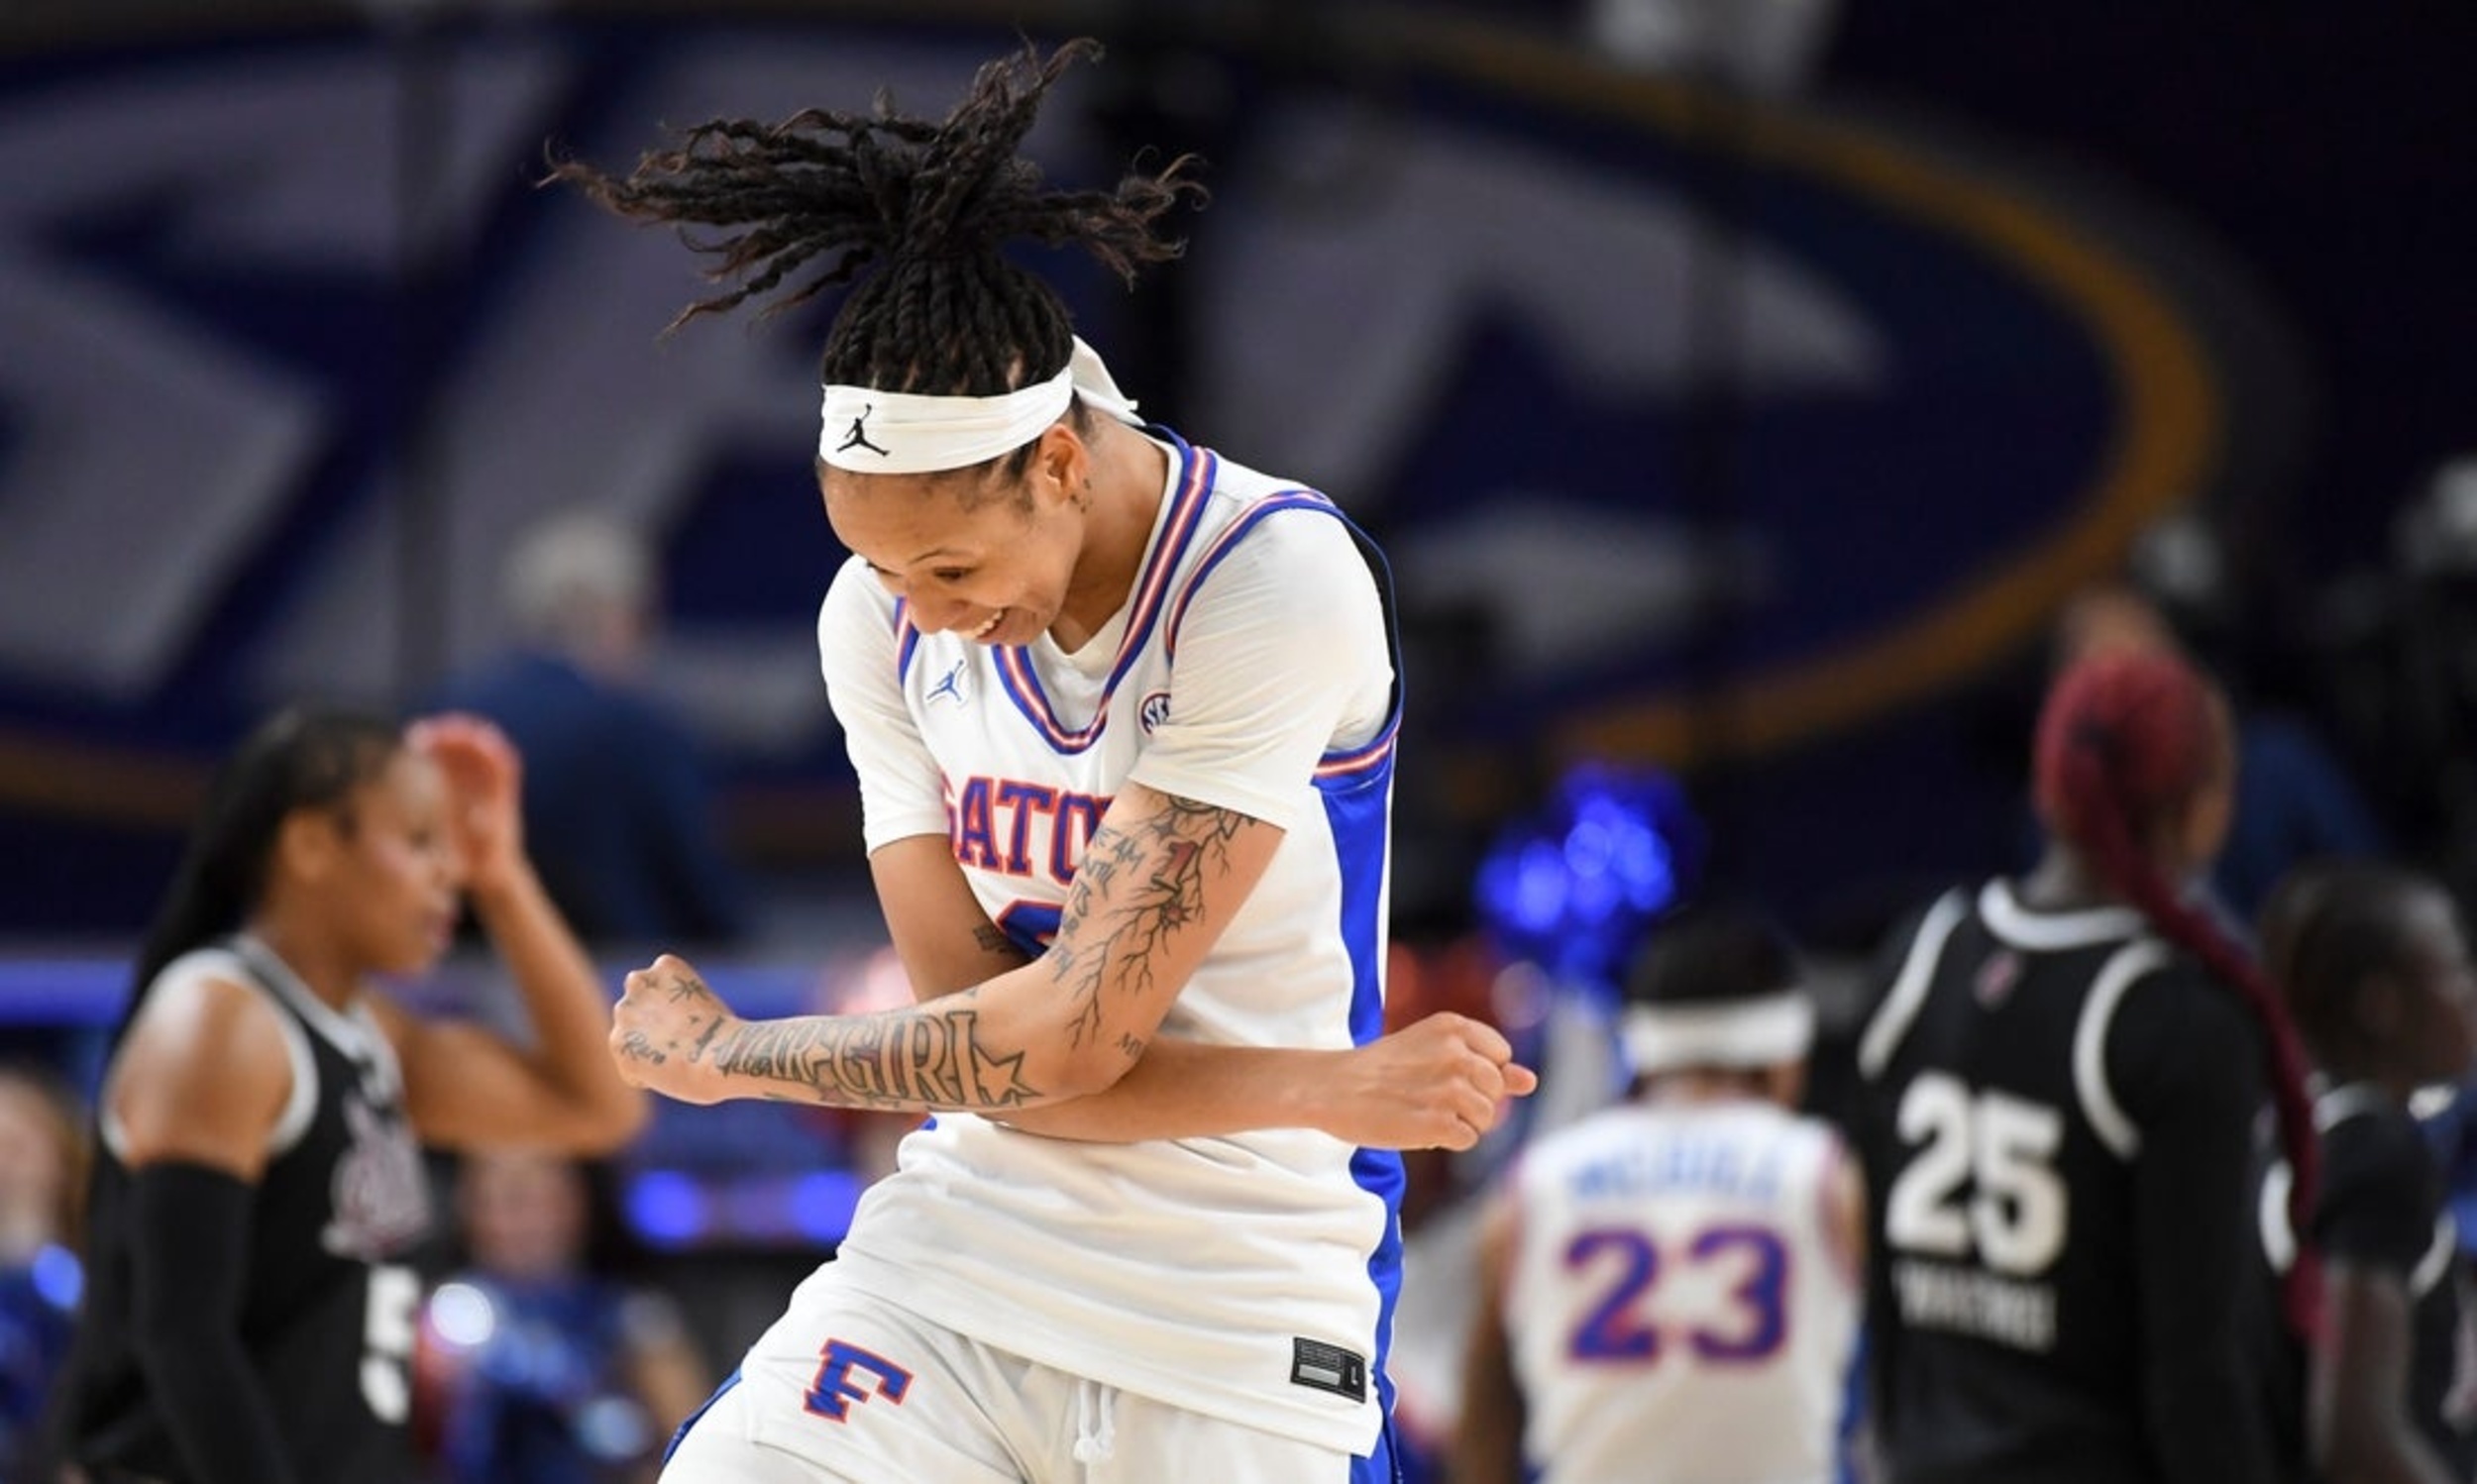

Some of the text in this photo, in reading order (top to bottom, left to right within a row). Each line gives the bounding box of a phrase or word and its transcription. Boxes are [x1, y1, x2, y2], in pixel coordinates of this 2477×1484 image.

[941, 771, 1116, 888] ATO
[1886, 1072, 2071, 1277] 25
[1562, 1226, 1794, 1367] 23
[803, 1336, 915, 1425] F
